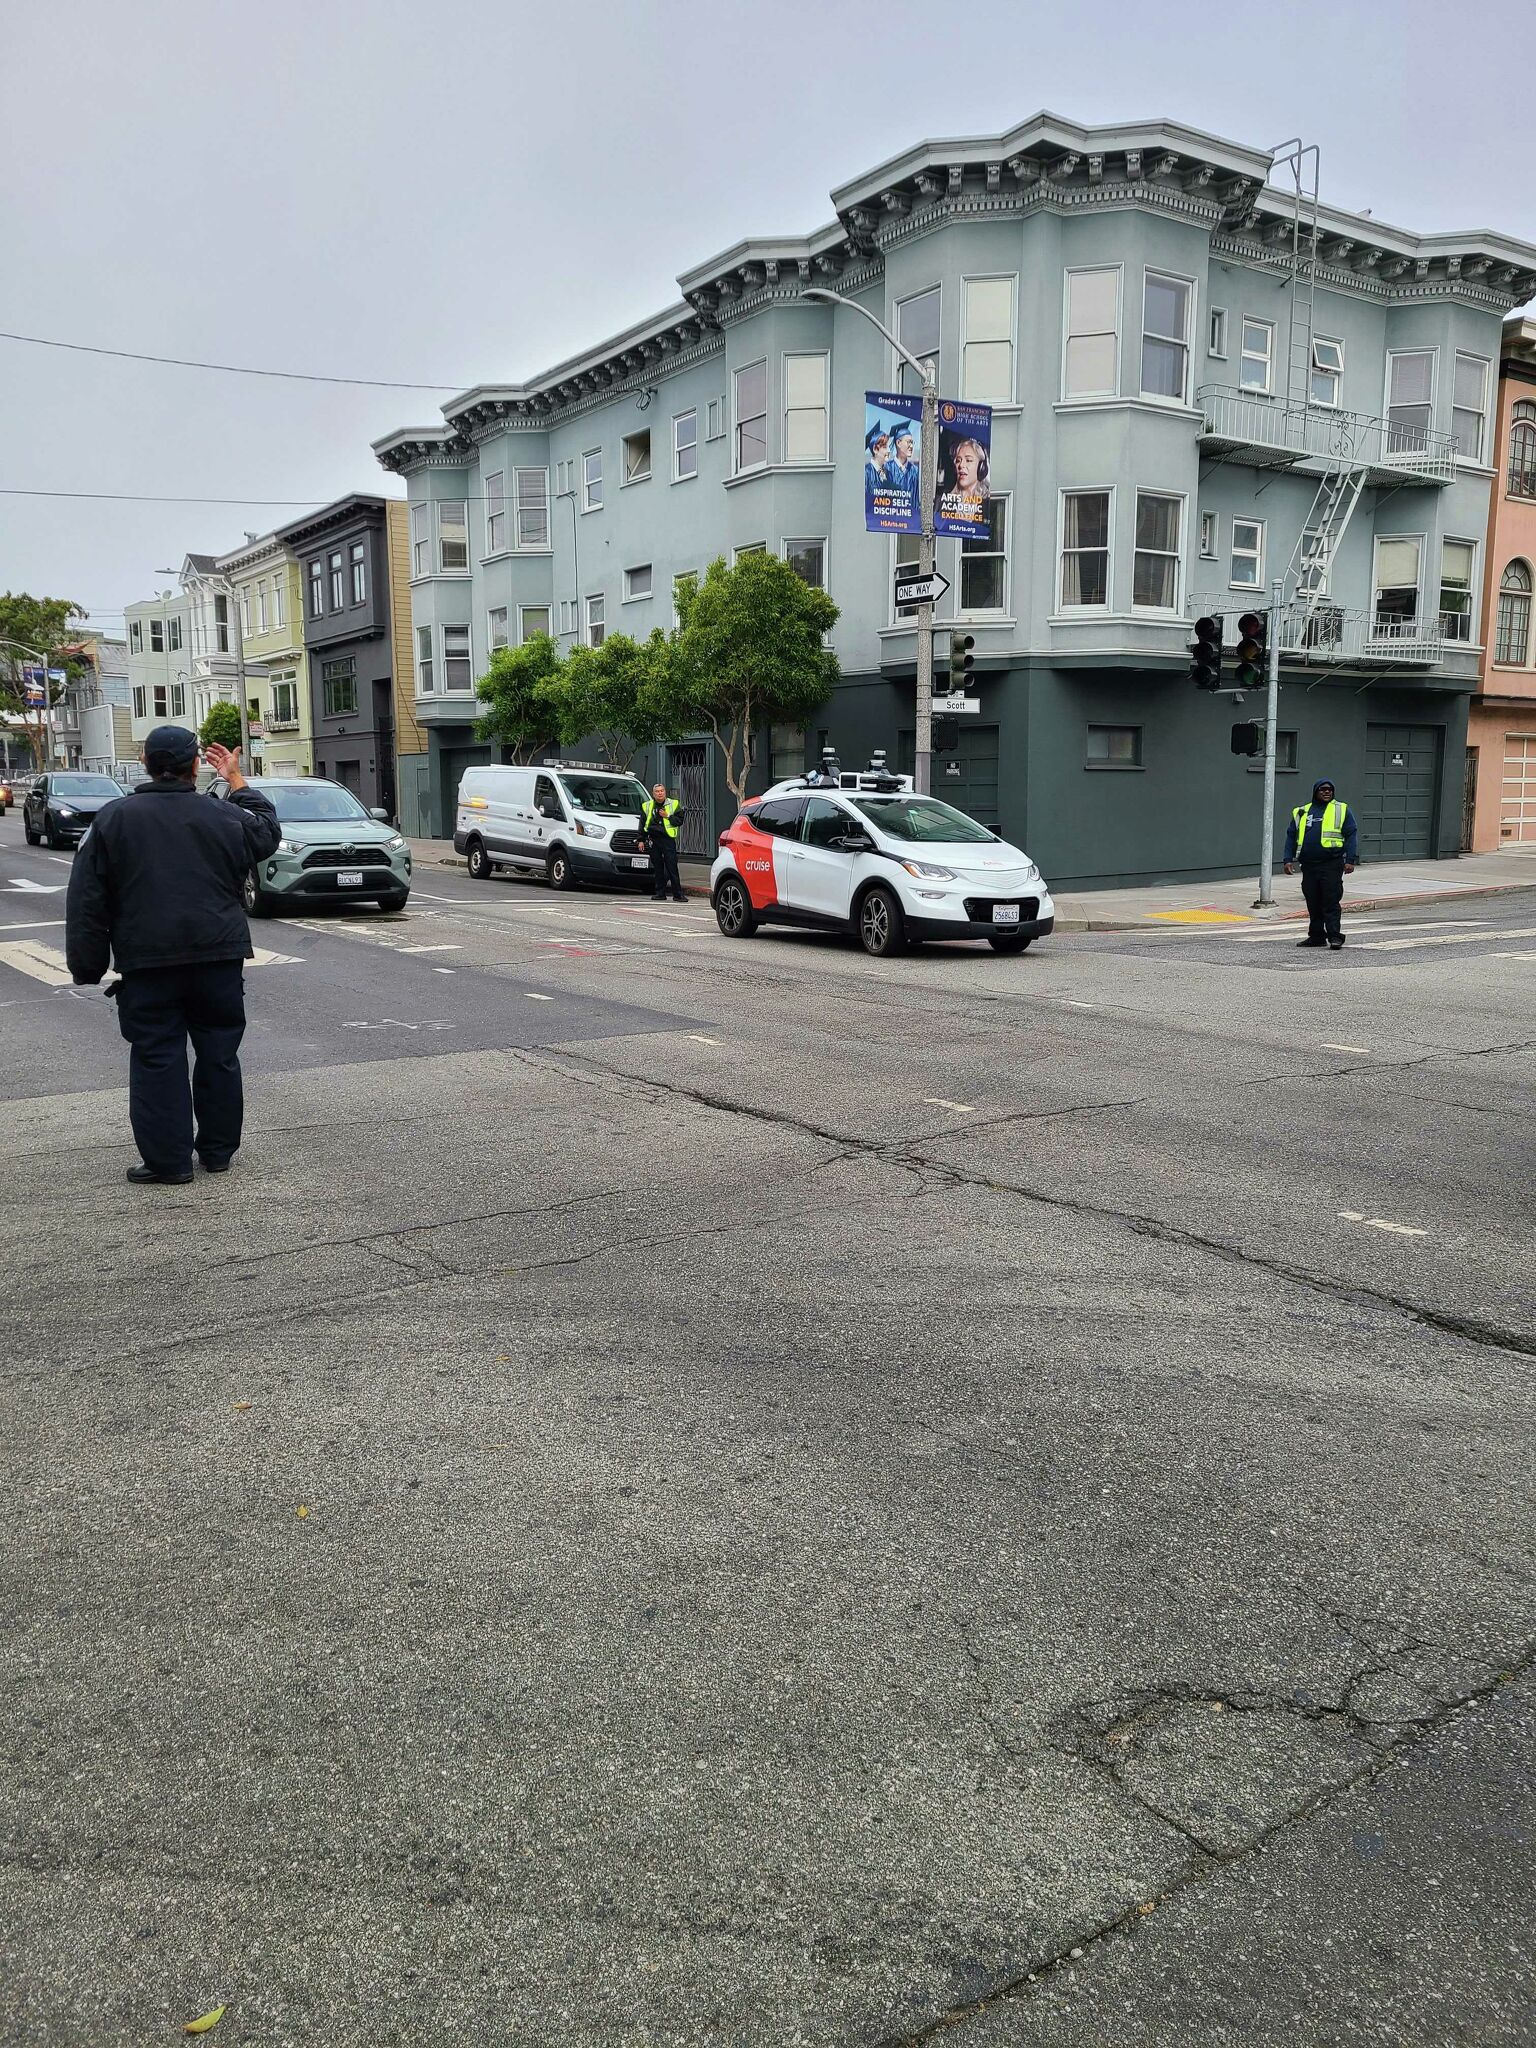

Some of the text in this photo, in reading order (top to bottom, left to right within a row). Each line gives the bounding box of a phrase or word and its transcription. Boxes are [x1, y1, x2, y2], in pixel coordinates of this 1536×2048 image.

[878, 396, 896, 405] Grades
[873, 488, 911, 498] INSPIRATION
[941, 492, 983, 504] ARTS AND
[874, 497, 911, 507] AND SELF-
[873, 506, 912, 517] DISCIPLINE
[941, 502, 983, 513] ACADEMIC
[941, 511, 983, 522] EXCELLENCE
[880, 520, 908, 529] HSArts.org
[949, 524, 976, 534] HSArts.org
[898, 583, 931, 598] ONE WAY
[946, 701, 965, 710] Scott
[745, 857, 771, 872] cruise
